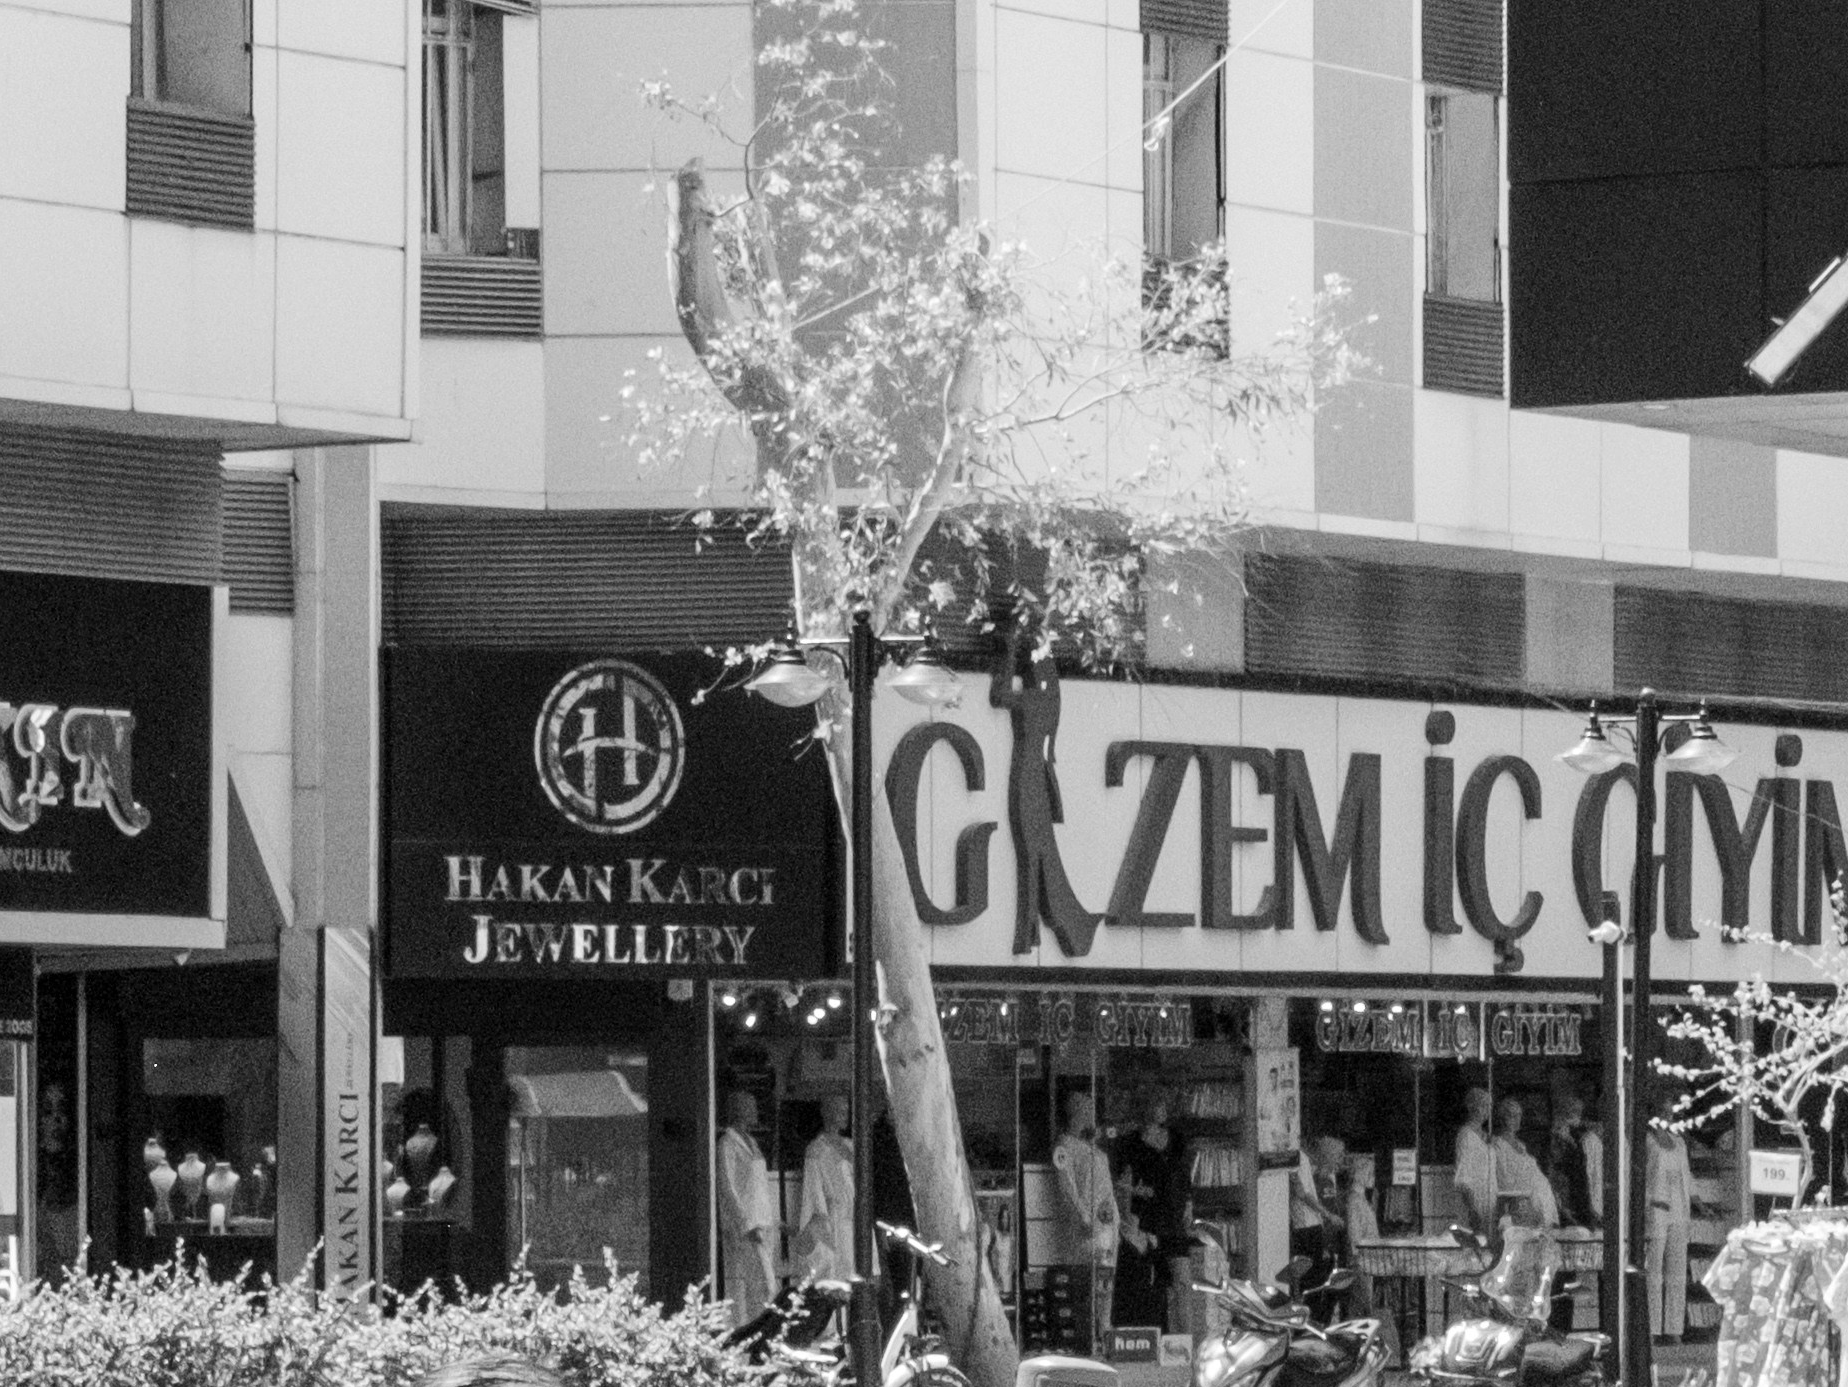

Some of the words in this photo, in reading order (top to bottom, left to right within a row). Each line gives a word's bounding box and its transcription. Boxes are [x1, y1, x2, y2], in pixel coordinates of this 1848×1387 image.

[1423, 709, 1545, 973] İÇ
[445, 854, 615, 903] HAKAN
[625, 858, 776, 905] KARCI
[462, 914, 755, 964] JEWELLERY
[338, 1205, 359, 1301] AKAN
